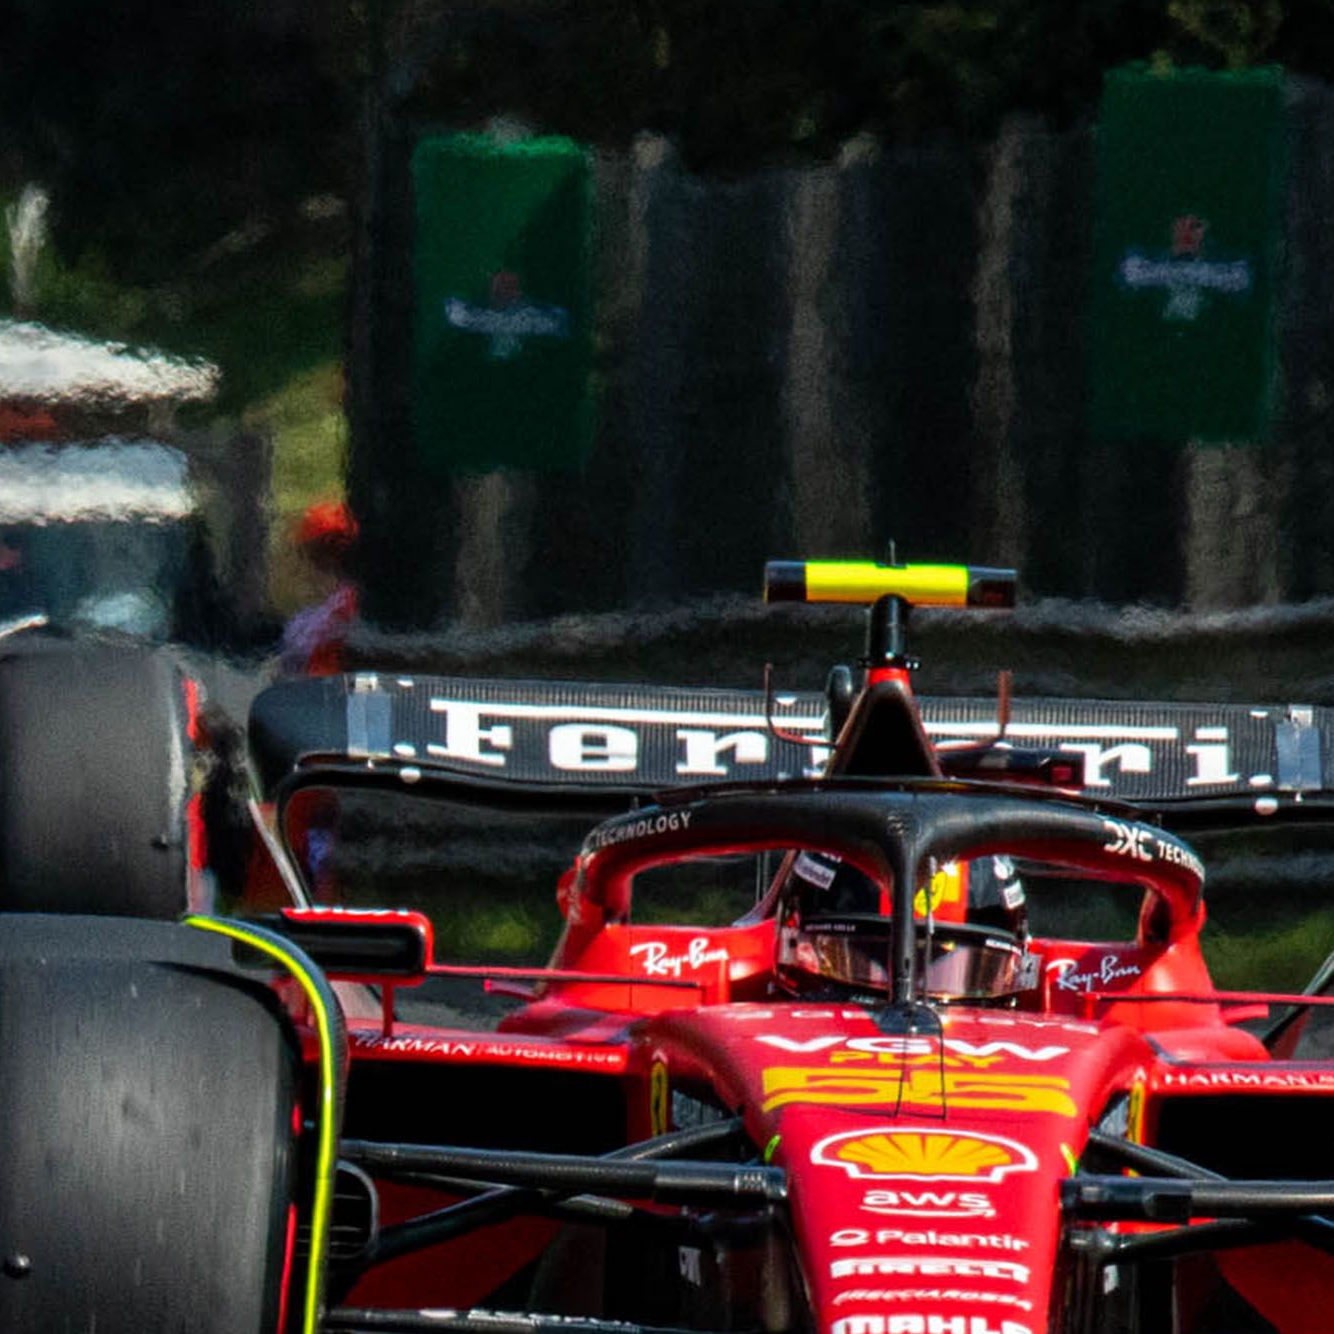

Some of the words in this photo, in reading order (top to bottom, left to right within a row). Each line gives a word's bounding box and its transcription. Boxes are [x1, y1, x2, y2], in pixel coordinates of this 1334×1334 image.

[427, 699, 1238, 786] Ferri
[630, 938, 729, 976] Ray-Ban
[1046, 956, 1142, 992] Ray-Ban
[754, 1035, 1070, 1060] VGW
[829, 1051, 1004, 1068] PLAY
[1164, 1072, 1305, 1086] HARMAN
[763, 1067, 1077, 1117] 55
[864, 1189, 990, 1208] aws
[876, 1230, 1030, 1251] Palantir
